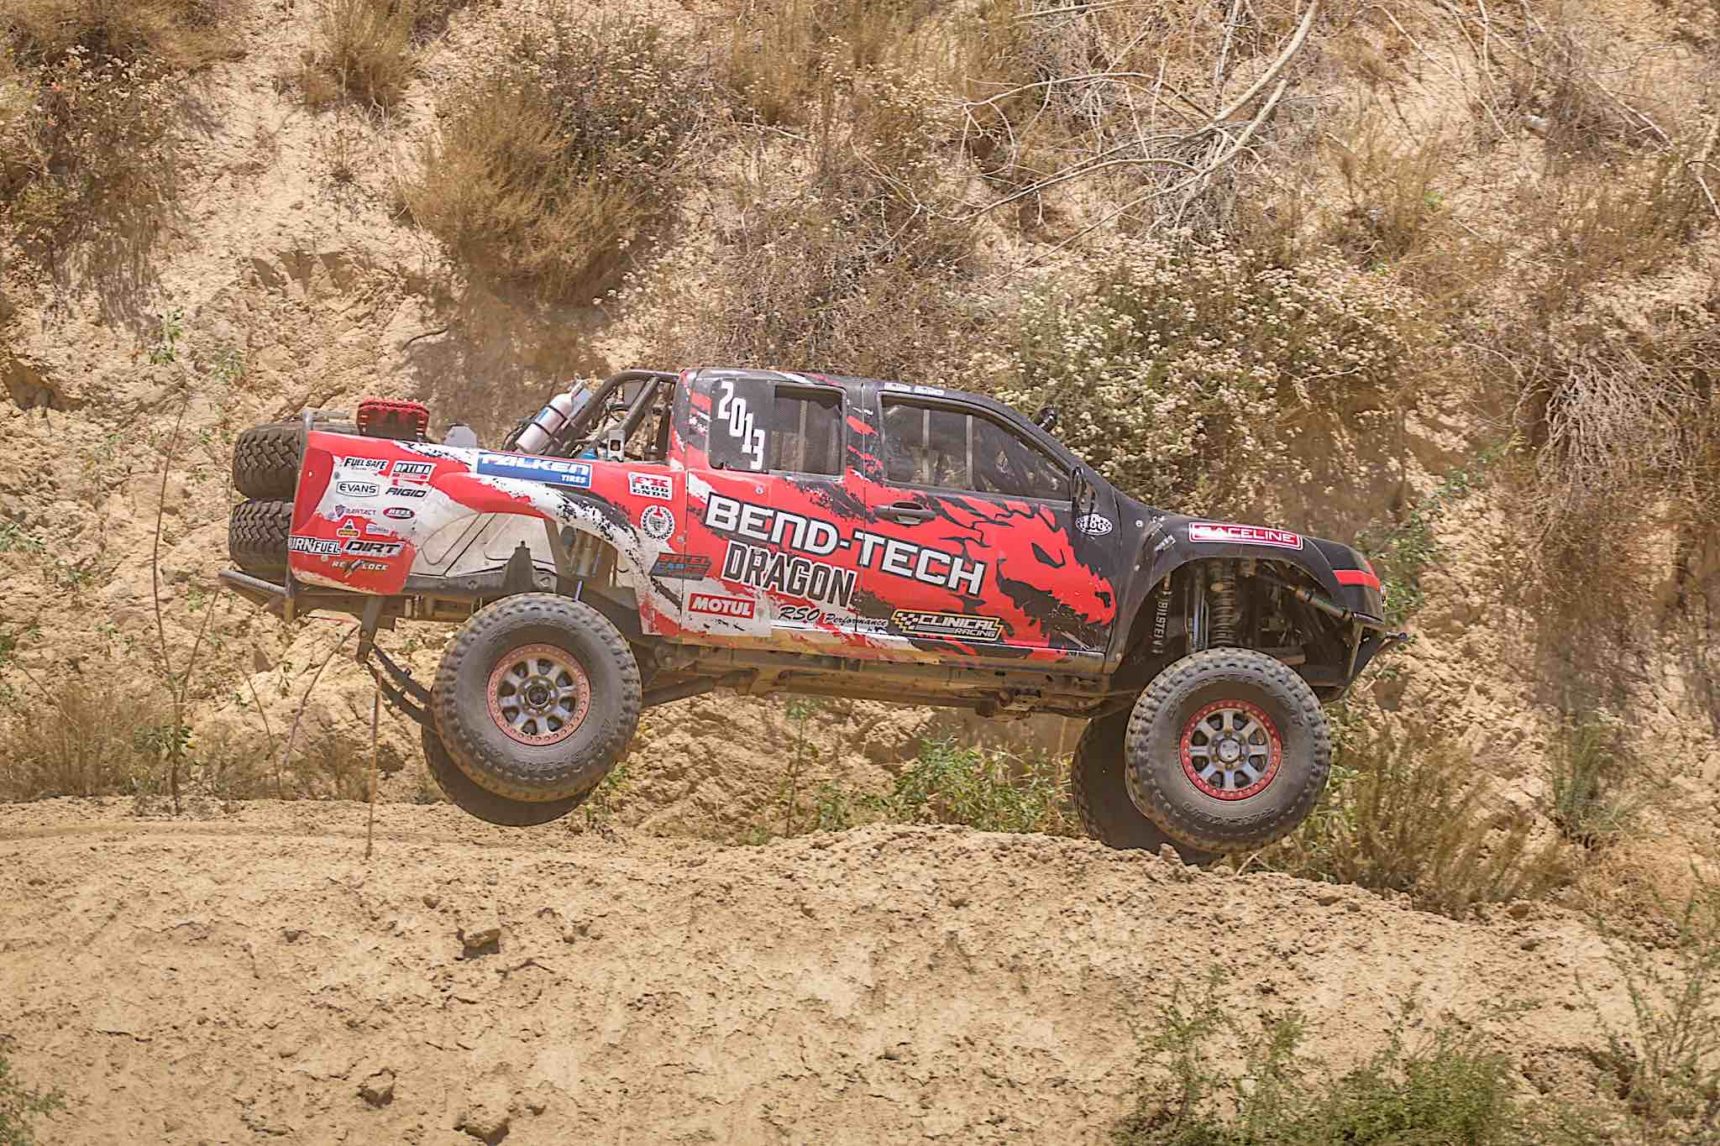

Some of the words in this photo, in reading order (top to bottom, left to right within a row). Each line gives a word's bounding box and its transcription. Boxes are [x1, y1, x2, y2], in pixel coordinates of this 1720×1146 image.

[718, 381, 765, 470] 2013
[344, 458, 365, 466] FUEL
[366, 461, 387, 469] SAFE
[394, 463, 431, 474] OPTIMA
[480, 453, 589, 473] FALKEN
[560, 475, 586, 483] TIRES
[339, 483, 377, 493] EVANS
[385, 487, 427, 498] RIGID
[1195, 526, 1295, 543] ACELINE
[345, 541, 400, 553] DIRT
[706, 494, 985, 596] BEND-TECH
[722, 541, 855, 608] DRAGON
[692, 597, 751, 616] MOTUL
[825, 613, 887, 627] Performance
[918, 615, 998, 630] CLINICAL
[954, 628, 995, 637] RACING
